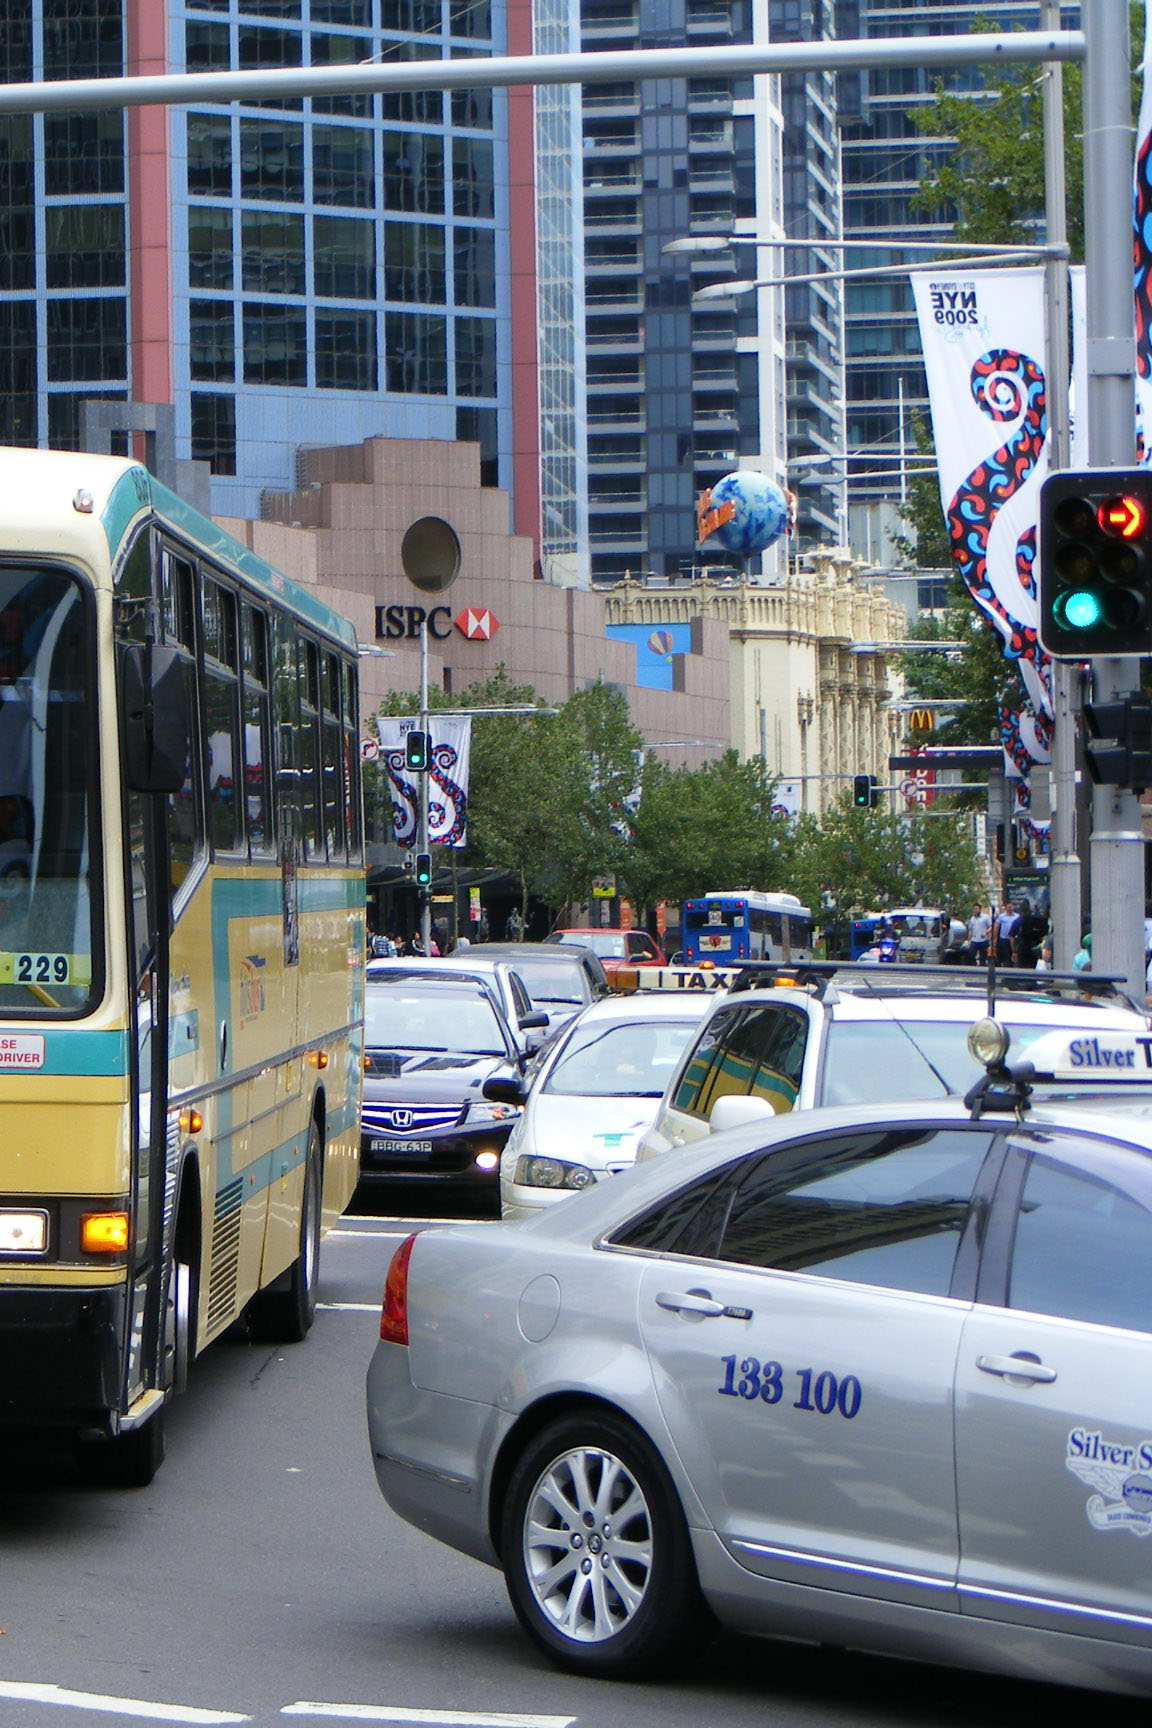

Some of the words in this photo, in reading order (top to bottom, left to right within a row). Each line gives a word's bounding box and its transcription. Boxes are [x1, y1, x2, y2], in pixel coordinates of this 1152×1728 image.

[17, 954, 69, 983] 229
[1069, 1037, 1135, 1067] Silver
[718, 1353, 784, 1405] 133
[793, 1367, 862, 1420] 100
[1070, 1430, 1134, 1466] Silver
